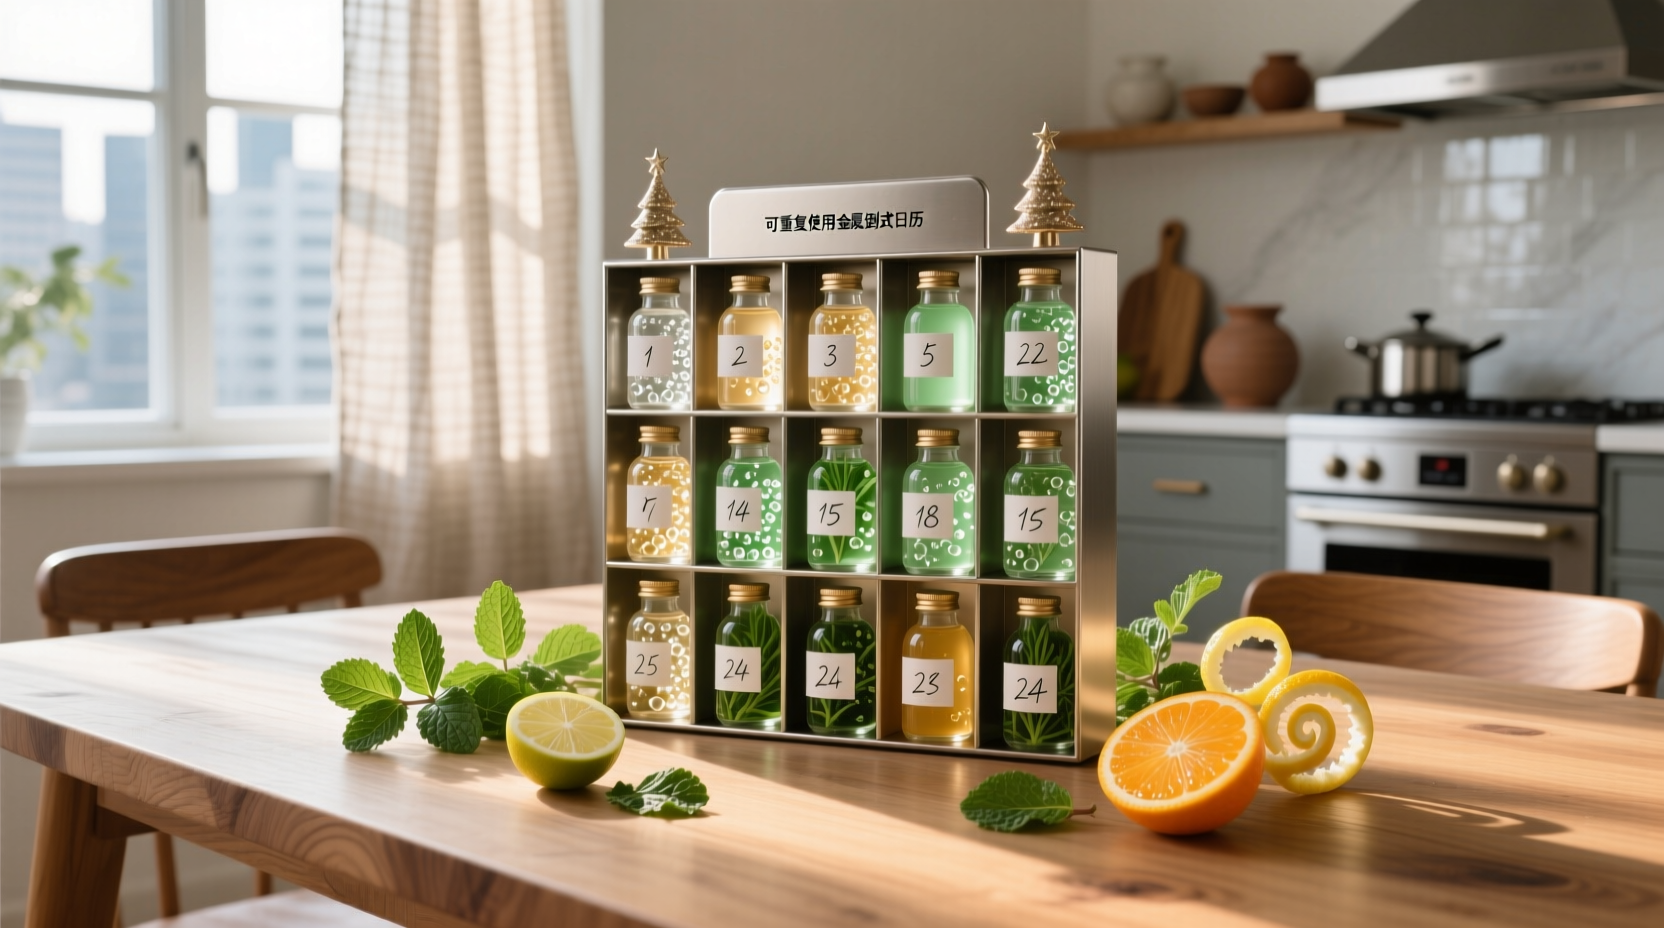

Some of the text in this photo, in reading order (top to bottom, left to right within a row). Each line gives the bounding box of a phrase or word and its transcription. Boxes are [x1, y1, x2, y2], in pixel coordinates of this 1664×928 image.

[645, 345, 653, 368] 1
[731, 346, 748, 366] 2
[823, 344, 837, 367] 3
[920, 342, 937, 367] 5
[1016, 342, 1048, 366] 22
[727, 499, 750, 523] 14
[818, 502, 844, 527] 15
[915, 504, 939, 529] 18
[1018, 507, 1047, 532] 15
[634, 653, 660, 676] 25
[723, 658, 750, 682] 24
[815, 665, 843, 690] 24
[912, 671, 940, 696] 23
[1014, 677, 1048, 704] 24
